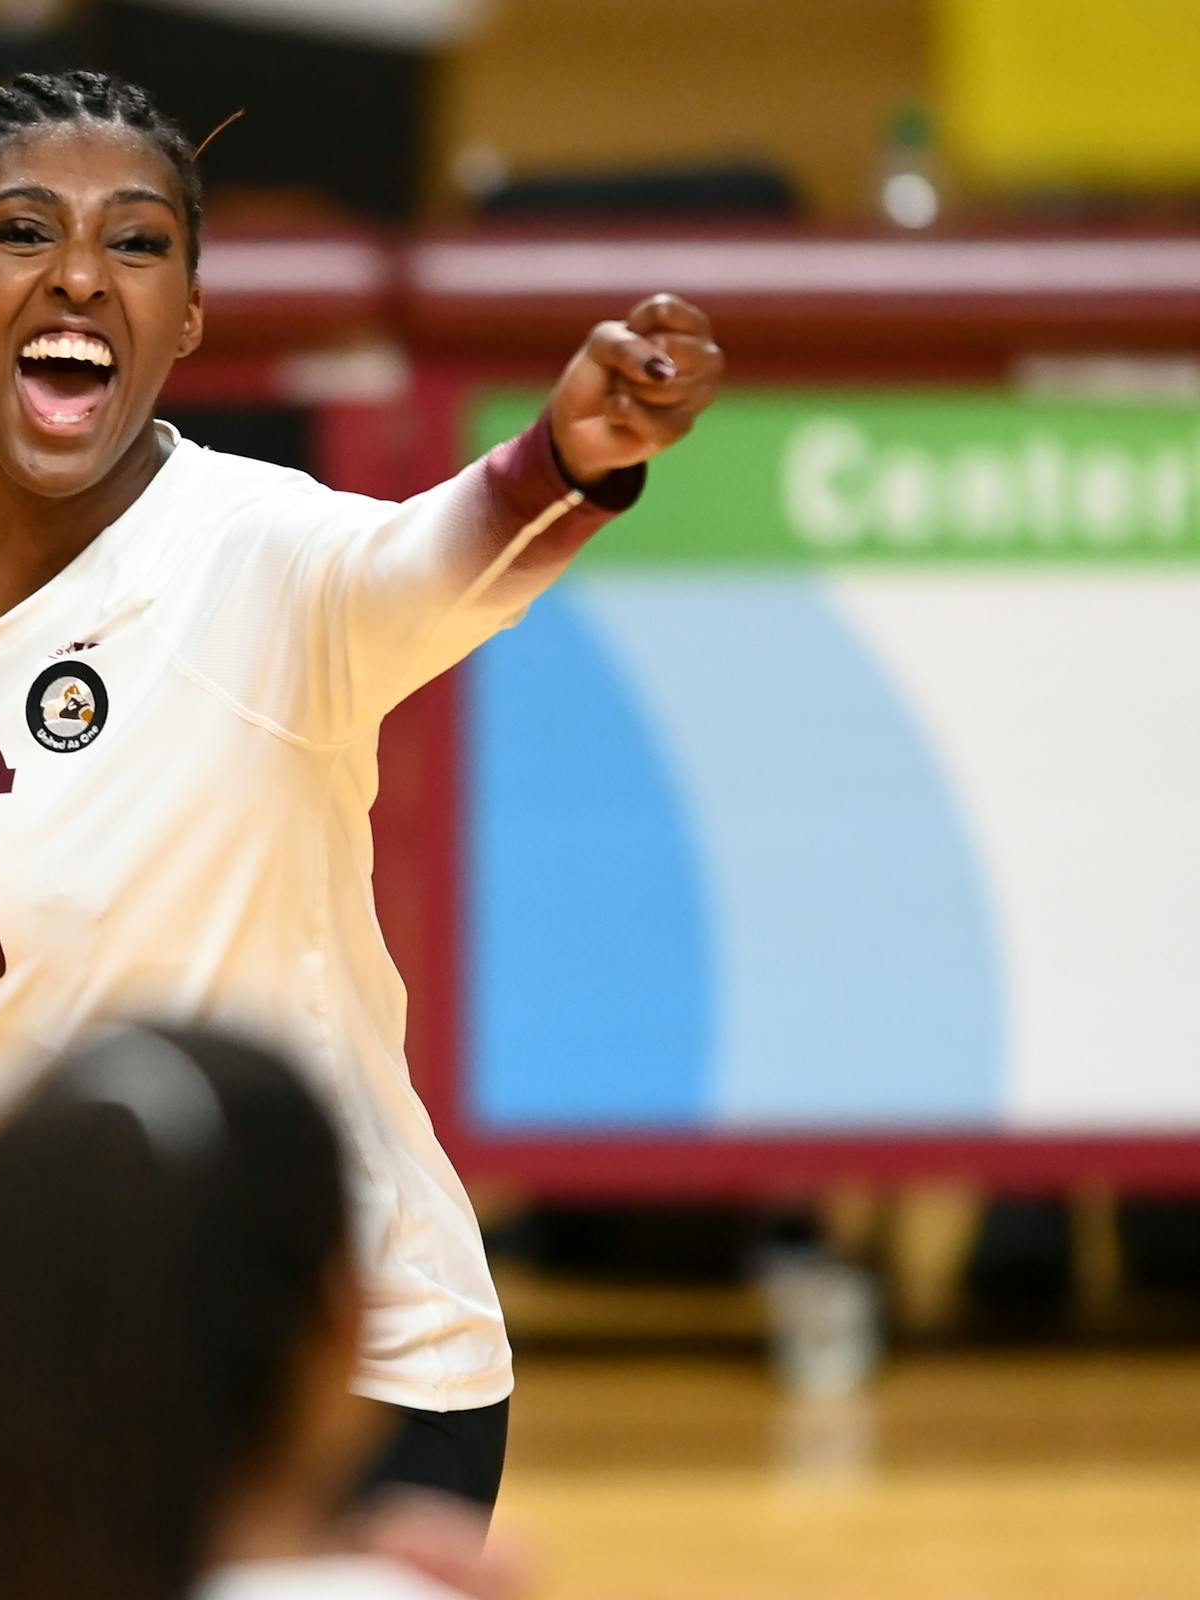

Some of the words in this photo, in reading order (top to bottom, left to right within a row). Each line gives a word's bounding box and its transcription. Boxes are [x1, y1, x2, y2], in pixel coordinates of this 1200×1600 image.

[781, 417, 1200, 546] Center
[36, 728, 66, 750] United
[67, 740, 81, 749] As
[80, 725, 99, 744] One
